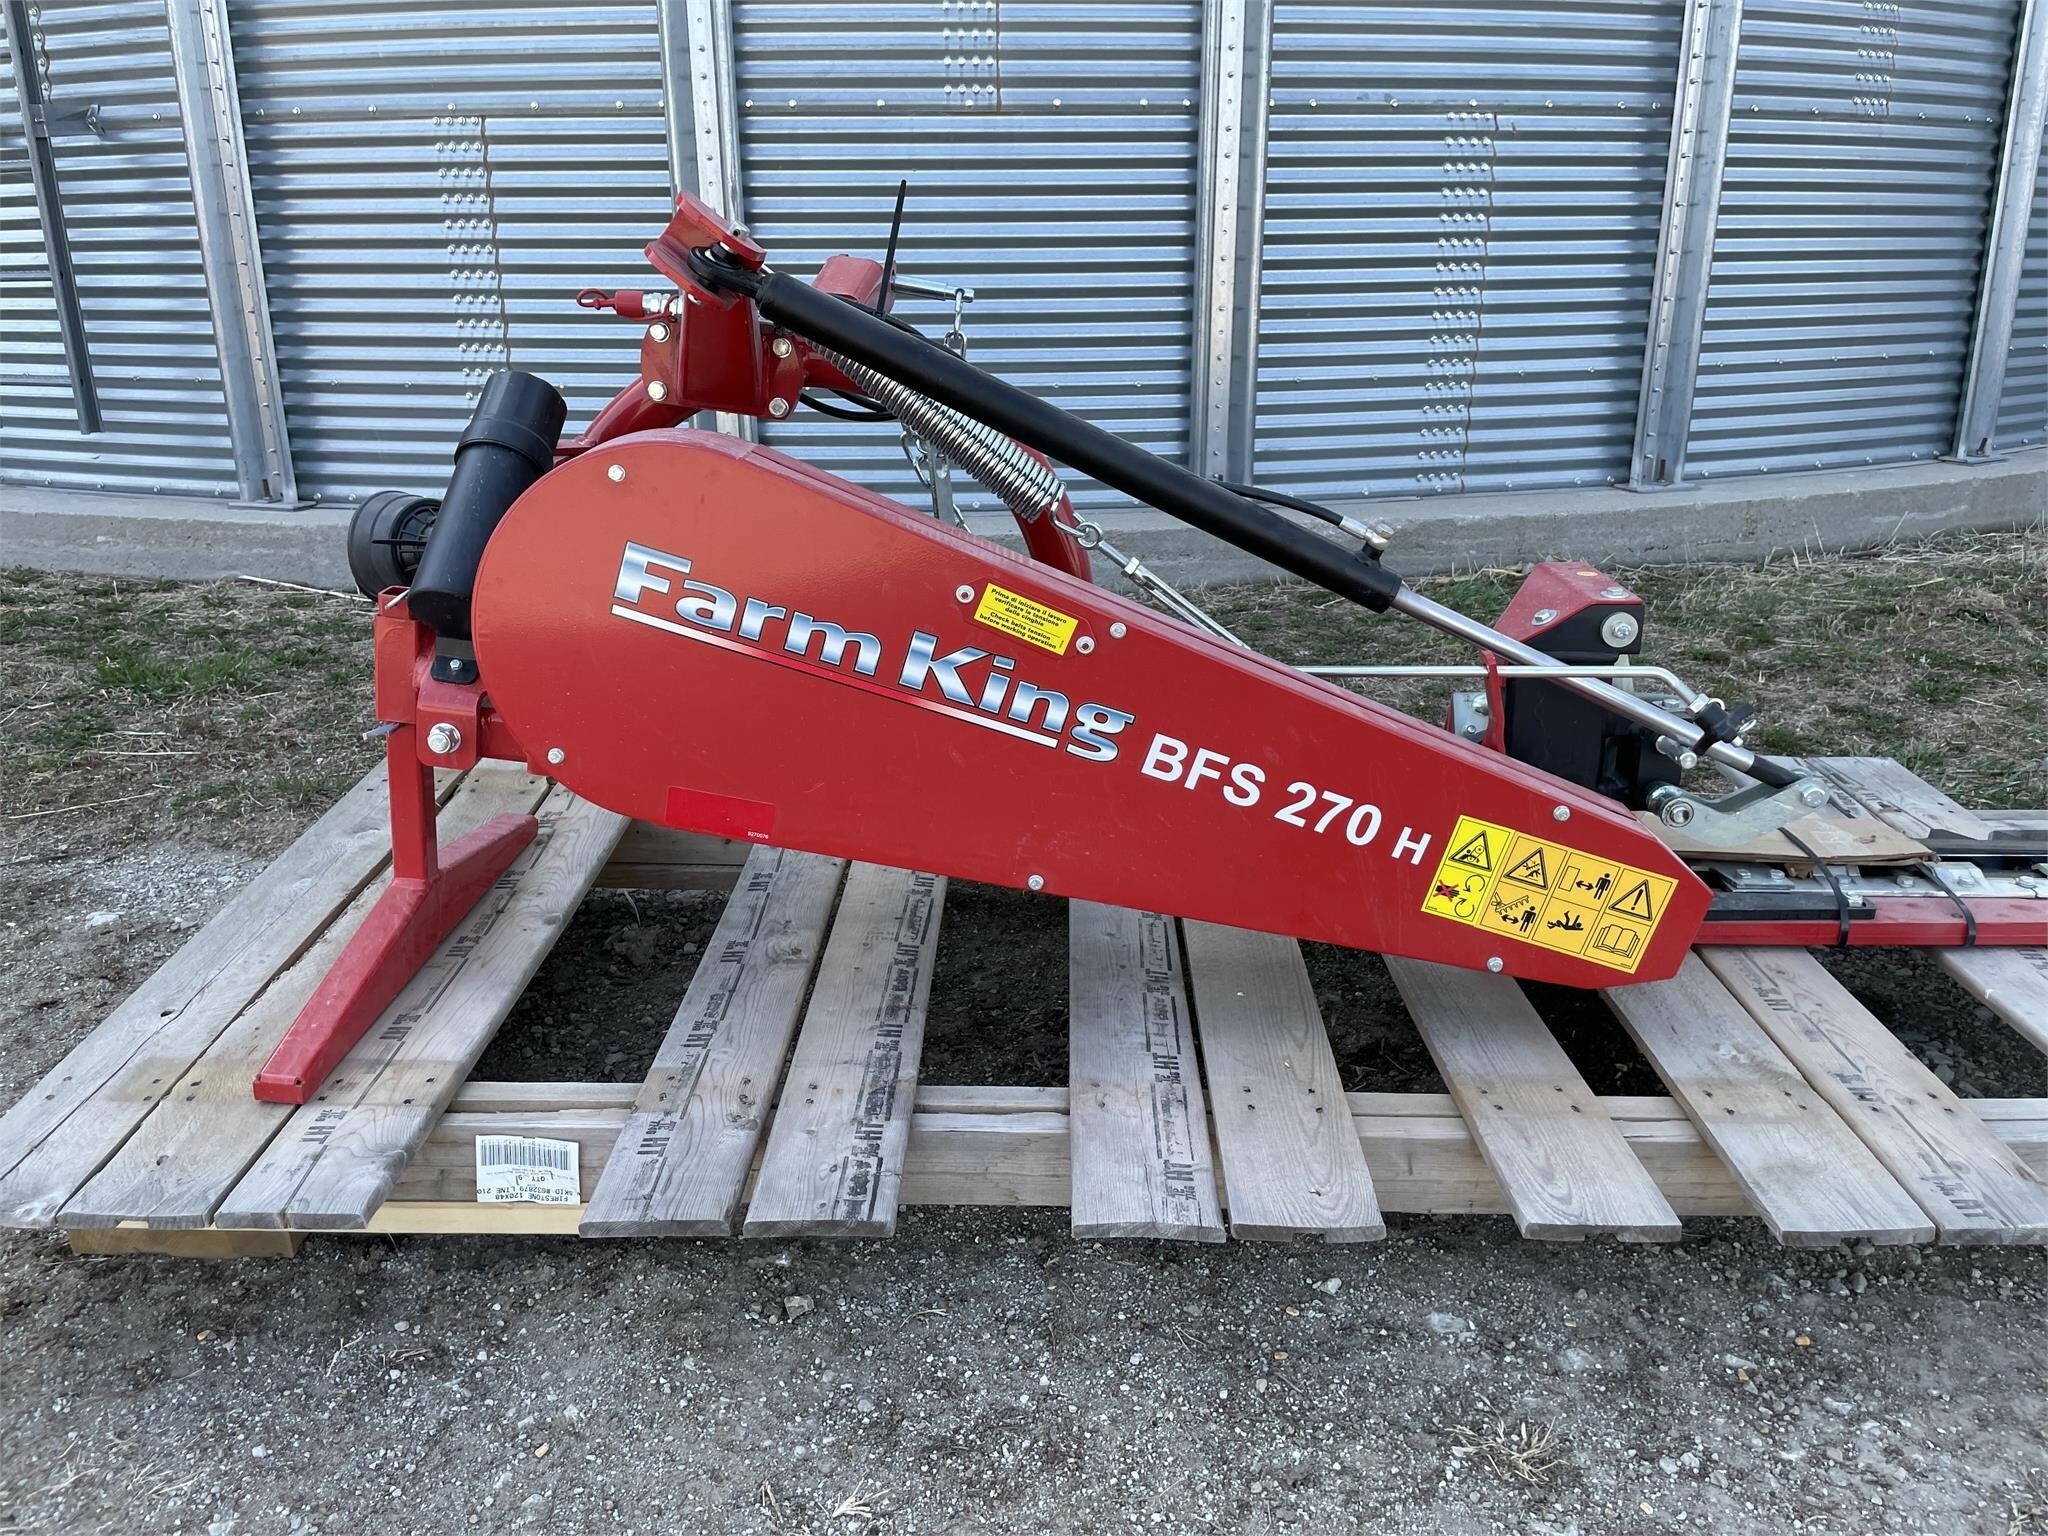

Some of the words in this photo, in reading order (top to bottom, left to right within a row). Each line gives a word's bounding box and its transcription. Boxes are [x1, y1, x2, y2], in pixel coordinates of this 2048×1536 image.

[991, 588, 1009, 600] Prima
[1018, 599, 1041, 613] iniziare
[1041, 607, 1047, 615] il
[1047, 611, 1067, 624] lavoro
[994, 596, 1024, 612] verificare
[1032, 611, 1059, 627] tensione
[979, 613, 1000, 626] before
[1001, 623, 1026, 637] working
[1027, 634, 1057, 649] operation
[990, 611, 1010, 623] Check
[1011, 619, 1027, 631] belts
[1027, 627, 1051, 641] tension
[1021, 613, 1044, 627] cinghie
[611, 541, 882, 677] Farm
[898, 630, 1136, 763] King
[1140, 733, 1266, 807] BFS
[1274, 781, 1382, 846] 270
[1391, 826, 1432, 865] H
[1152, 1053, 1180, 1070] HT
[299, 1125, 337, 1144] HT
[636, 1136, 670, 1158] HT
[1163, 1159, 1195, 1182] HT
[495, 1192, 523, 1200] 120X48
[496, 1186, 516, 1194] LINE
[528, 1192, 569, 1202] FIRESTONE
[555, 1188, 573, 1196] SKID
